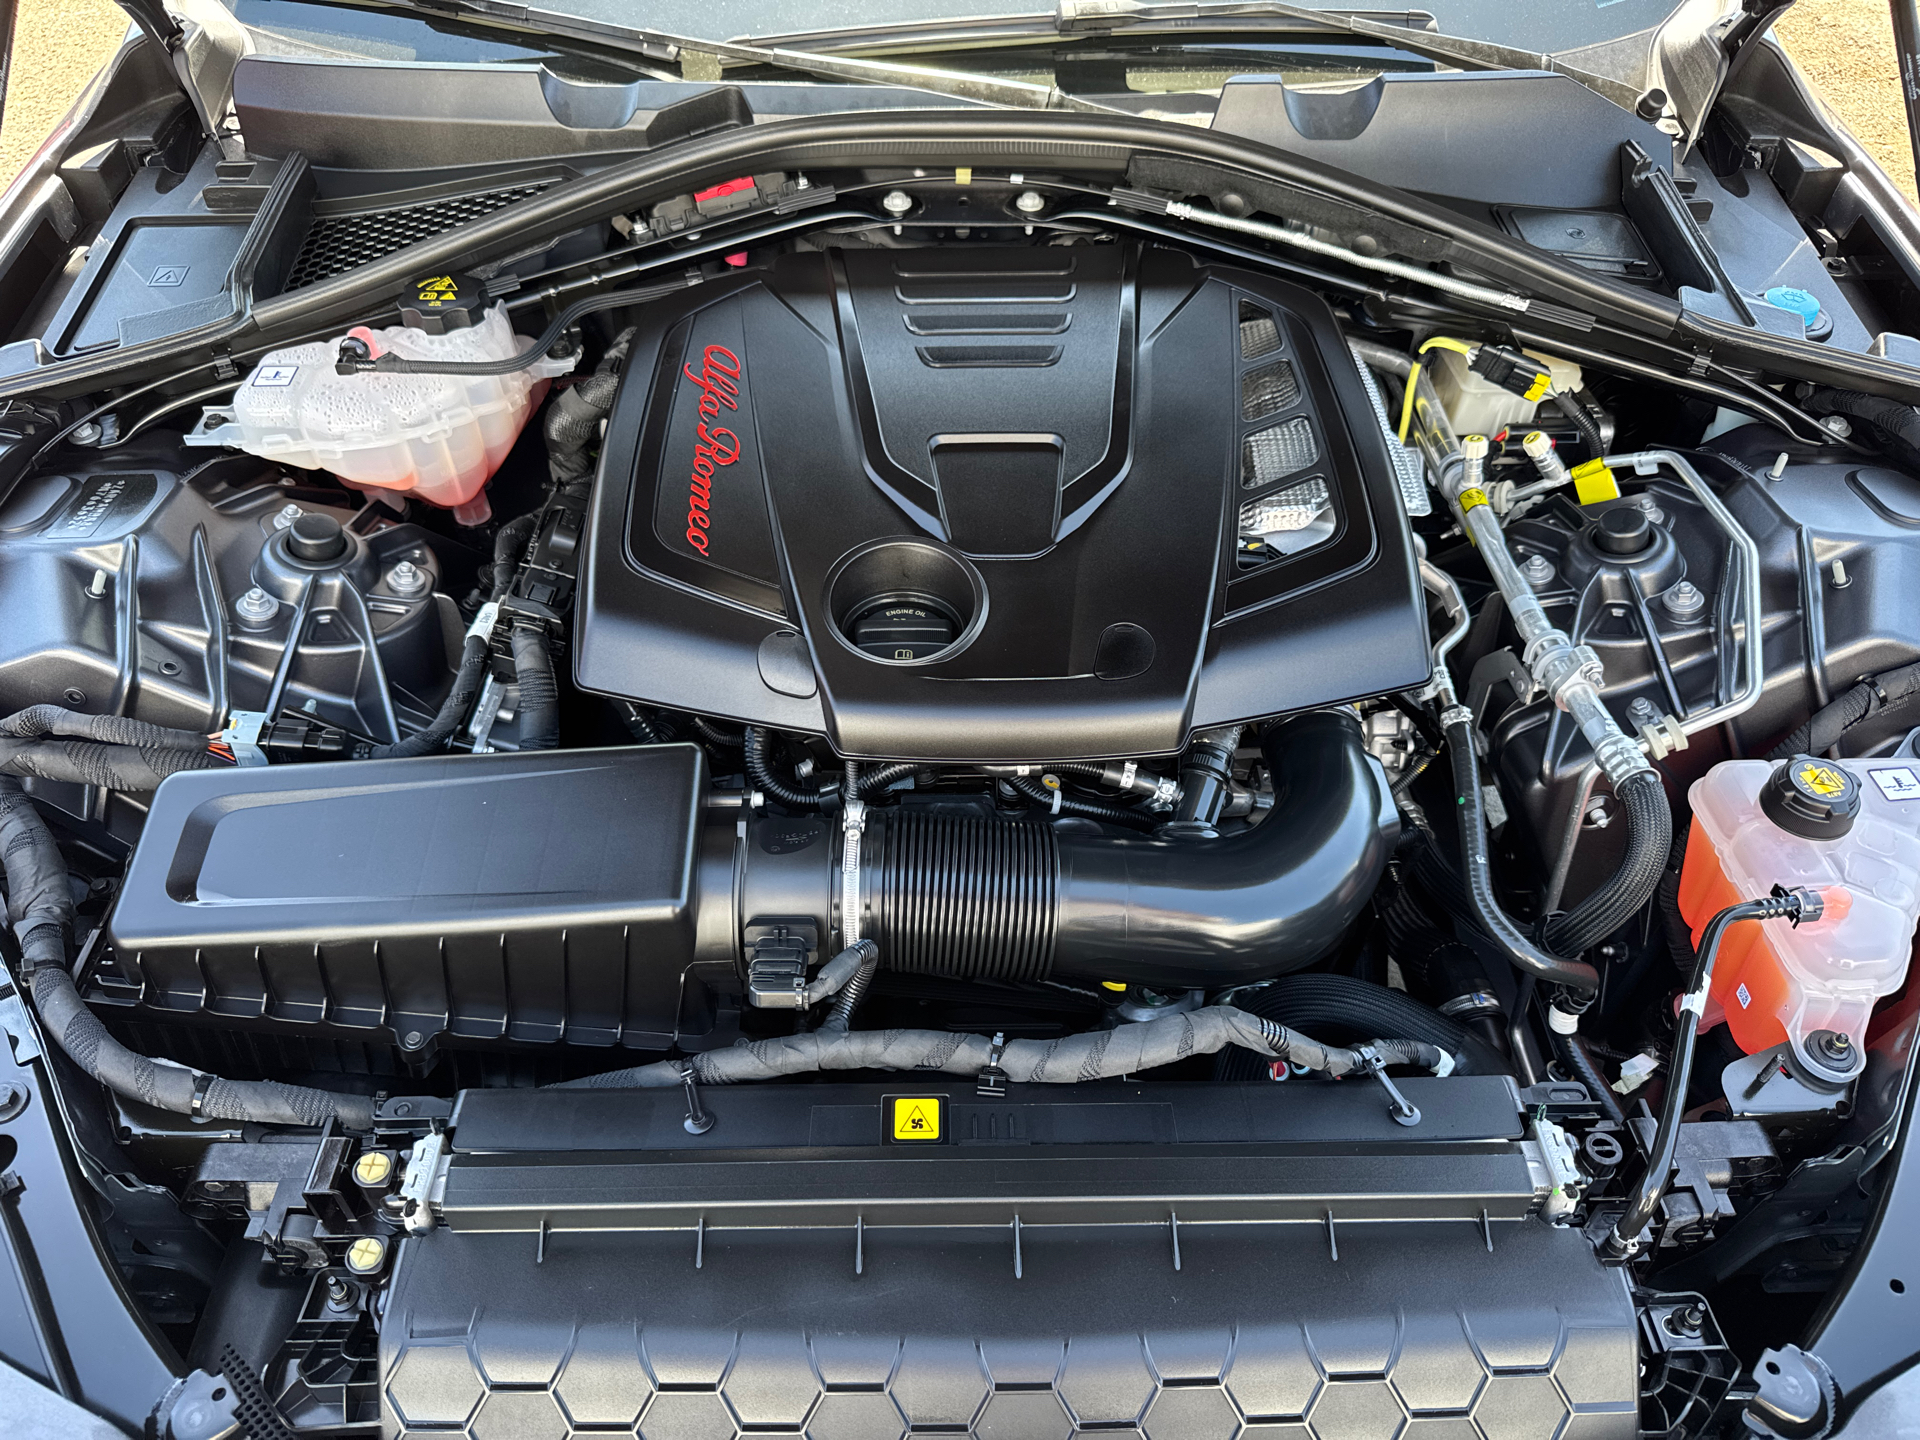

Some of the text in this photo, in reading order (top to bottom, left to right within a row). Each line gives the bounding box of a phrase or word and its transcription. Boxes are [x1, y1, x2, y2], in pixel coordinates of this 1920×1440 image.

[683, 345, 741, 557] Alfa Romeo
[886, 609, 926, 618] ENGINE OIL
